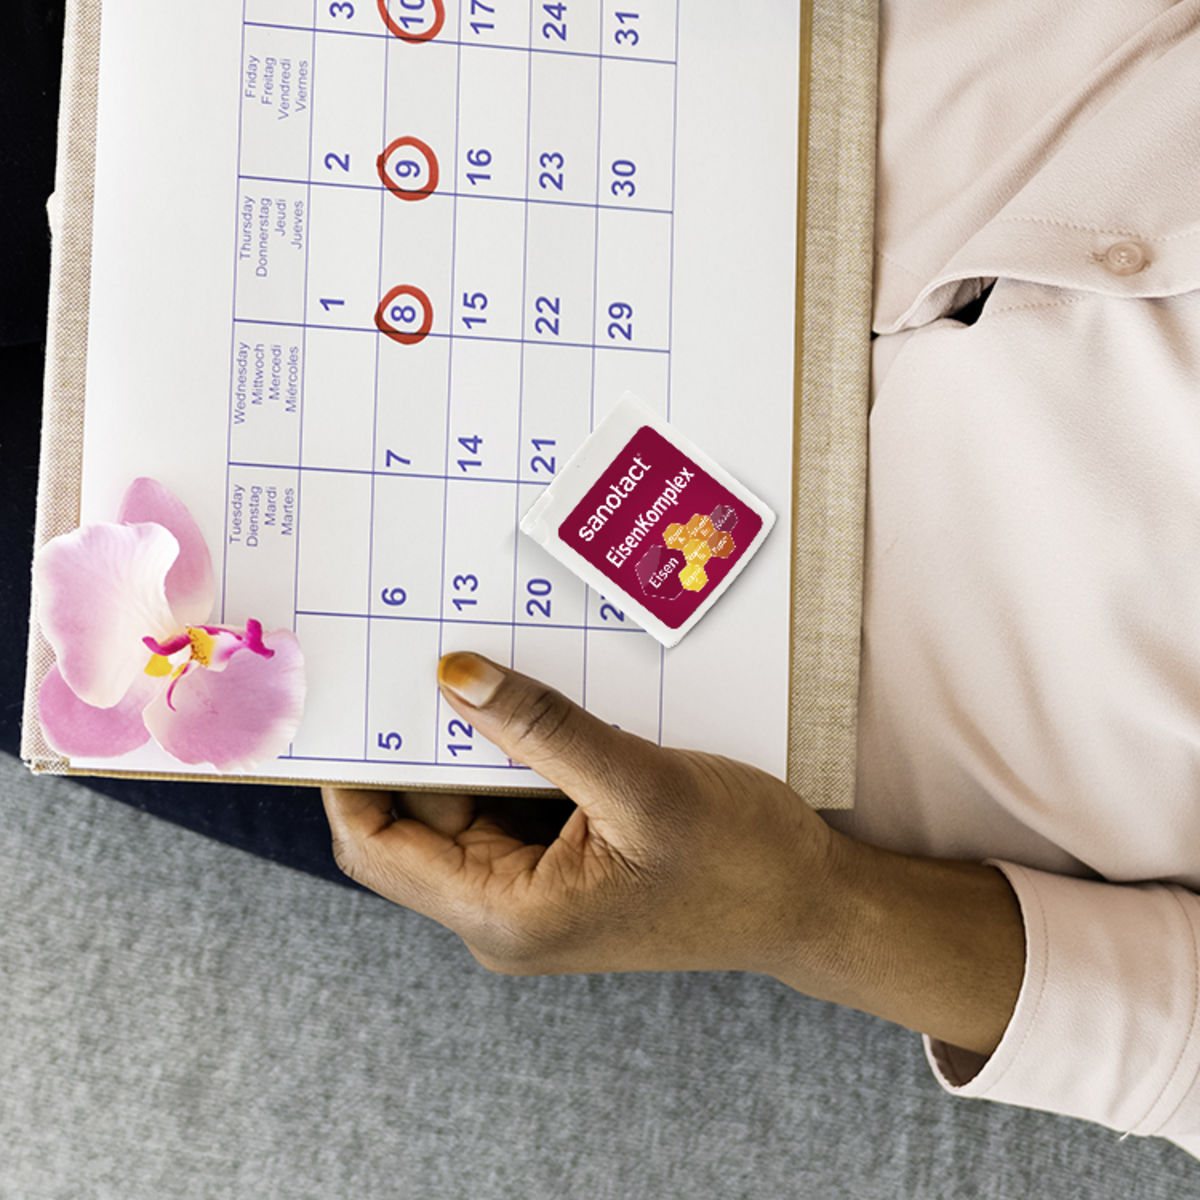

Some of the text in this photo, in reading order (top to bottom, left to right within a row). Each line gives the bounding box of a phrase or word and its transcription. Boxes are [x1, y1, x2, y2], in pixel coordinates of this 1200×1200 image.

[329, 2, 355, 20] 3
[542, 2, 567, 40] 24
[615, 9, 640, 46] 31
[245, 54, 260, 98] Friday
[261, 57, 276, 105] Freitag
[277, 57, 291, 120] Vendredi
[295, 60, 308, 113] Viernes
[324, 152, 350, 171] 2
[395, 160, 421, 179] 9
[467, 148, 492, 185] 16
[538, 152, 564, 190] 23
[611, 159, 636, 198] 30
[239, 195, 254, 259] Thursday
[274, 198, 286, 236] Jeudi
[290, 200, 304, 250] Jueves
[256, 197, 271, 277] Donnerstag
[319, 296, 345, 310] 1
[391, 305, 416, 323] 8
[462, 292, 488, 329] 15
[535, 297, 560, 335] 22
[608, 301, 633, 340] 29
[234, 341, 250, 424] Wednesday
[251, 343, 264, 405] Mittwoch
[285, 346, 300, 413] Miércoles
[386, 449, 412, 467] 7
[458, 434, 483, 472] 14
[530, 437, 556, 474] 21
[229, 483, 245, 543] Tuesday
[246, 485, 262, 547] Dienstag
[264, 485, 277, 526] Mardi
[281, 487, 294, 536] Martes
[605, 466, 695, 569] EisenKomplex
[452, 573, 478, 611] 13
[647, 557, 679, 589] Eisen
[381, 587, 407, 606] 6
[526, 578, 552, 617] 20
[601, 596, 625, 621] 2
[377, 731, 403, 750] 5
[447, 719, 474, 756] 12
